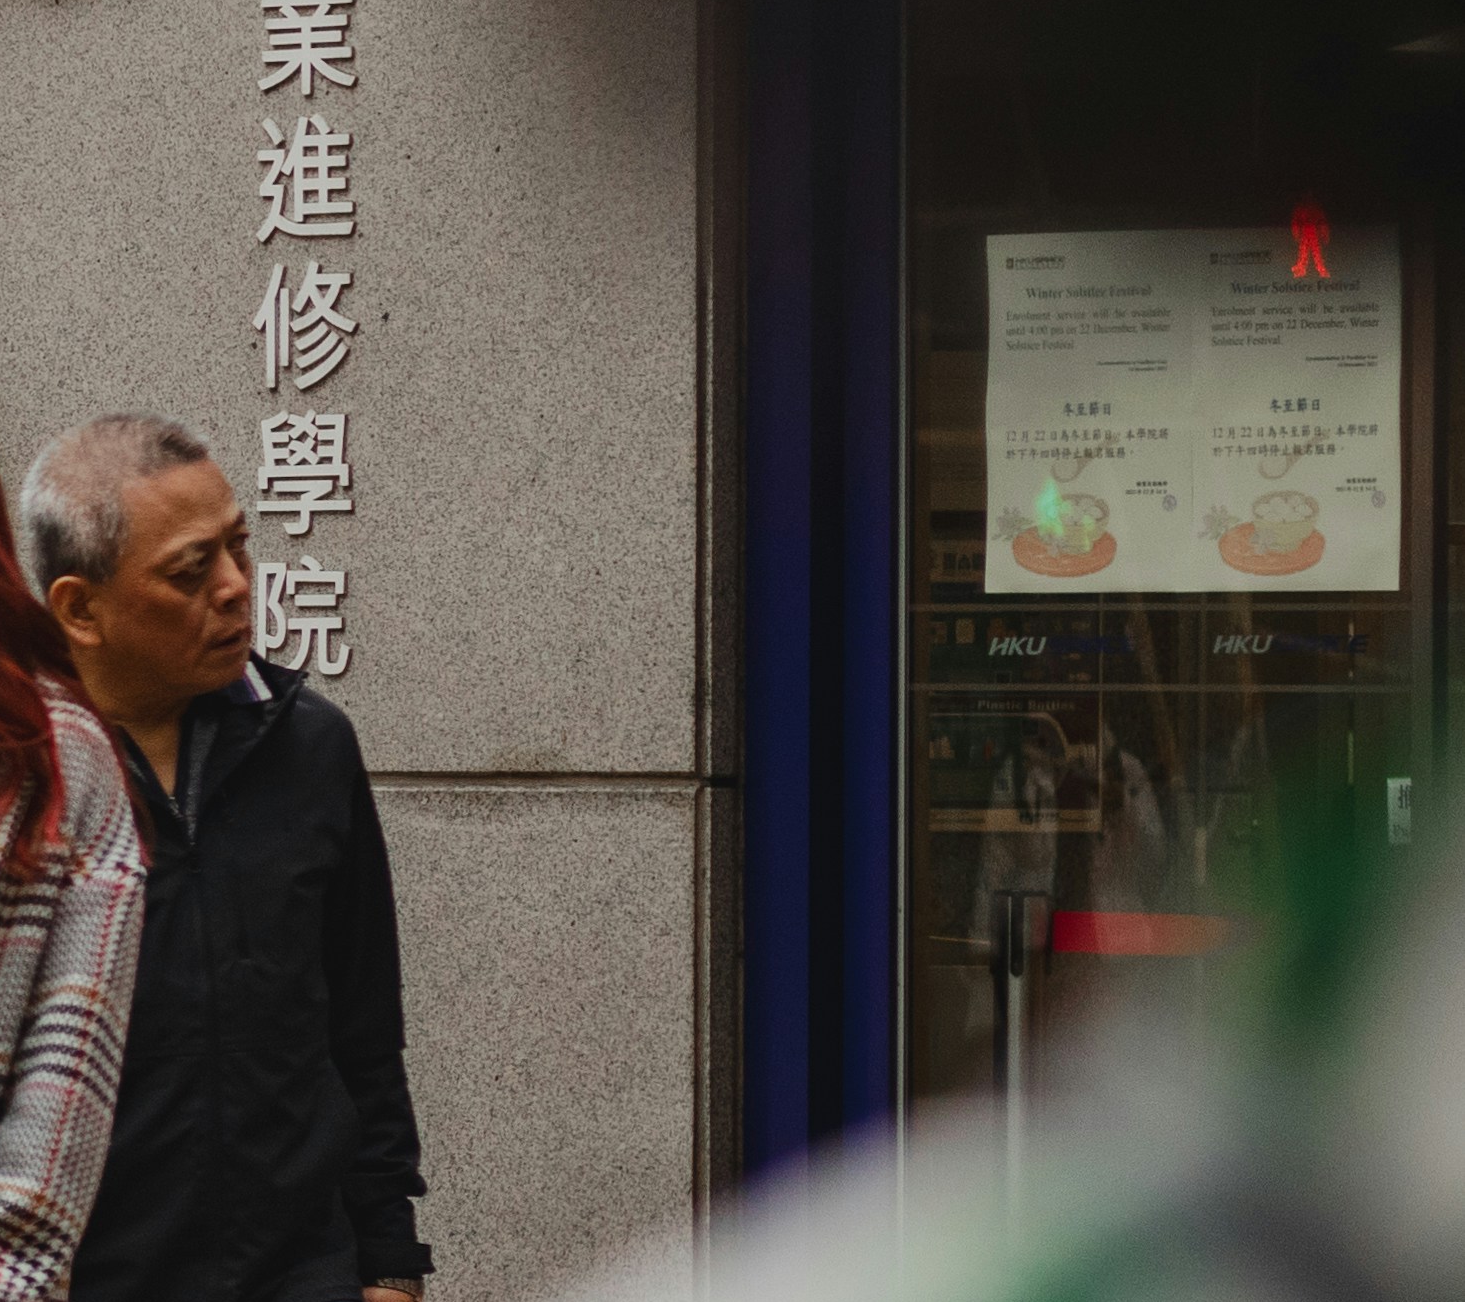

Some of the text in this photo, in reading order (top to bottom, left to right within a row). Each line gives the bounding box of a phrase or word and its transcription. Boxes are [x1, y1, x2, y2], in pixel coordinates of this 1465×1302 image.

[1231, 280, 1268, 294] Winter
[988, 635, 1047, 656] HKU
[1213, 633, 1273, 655] HKU
